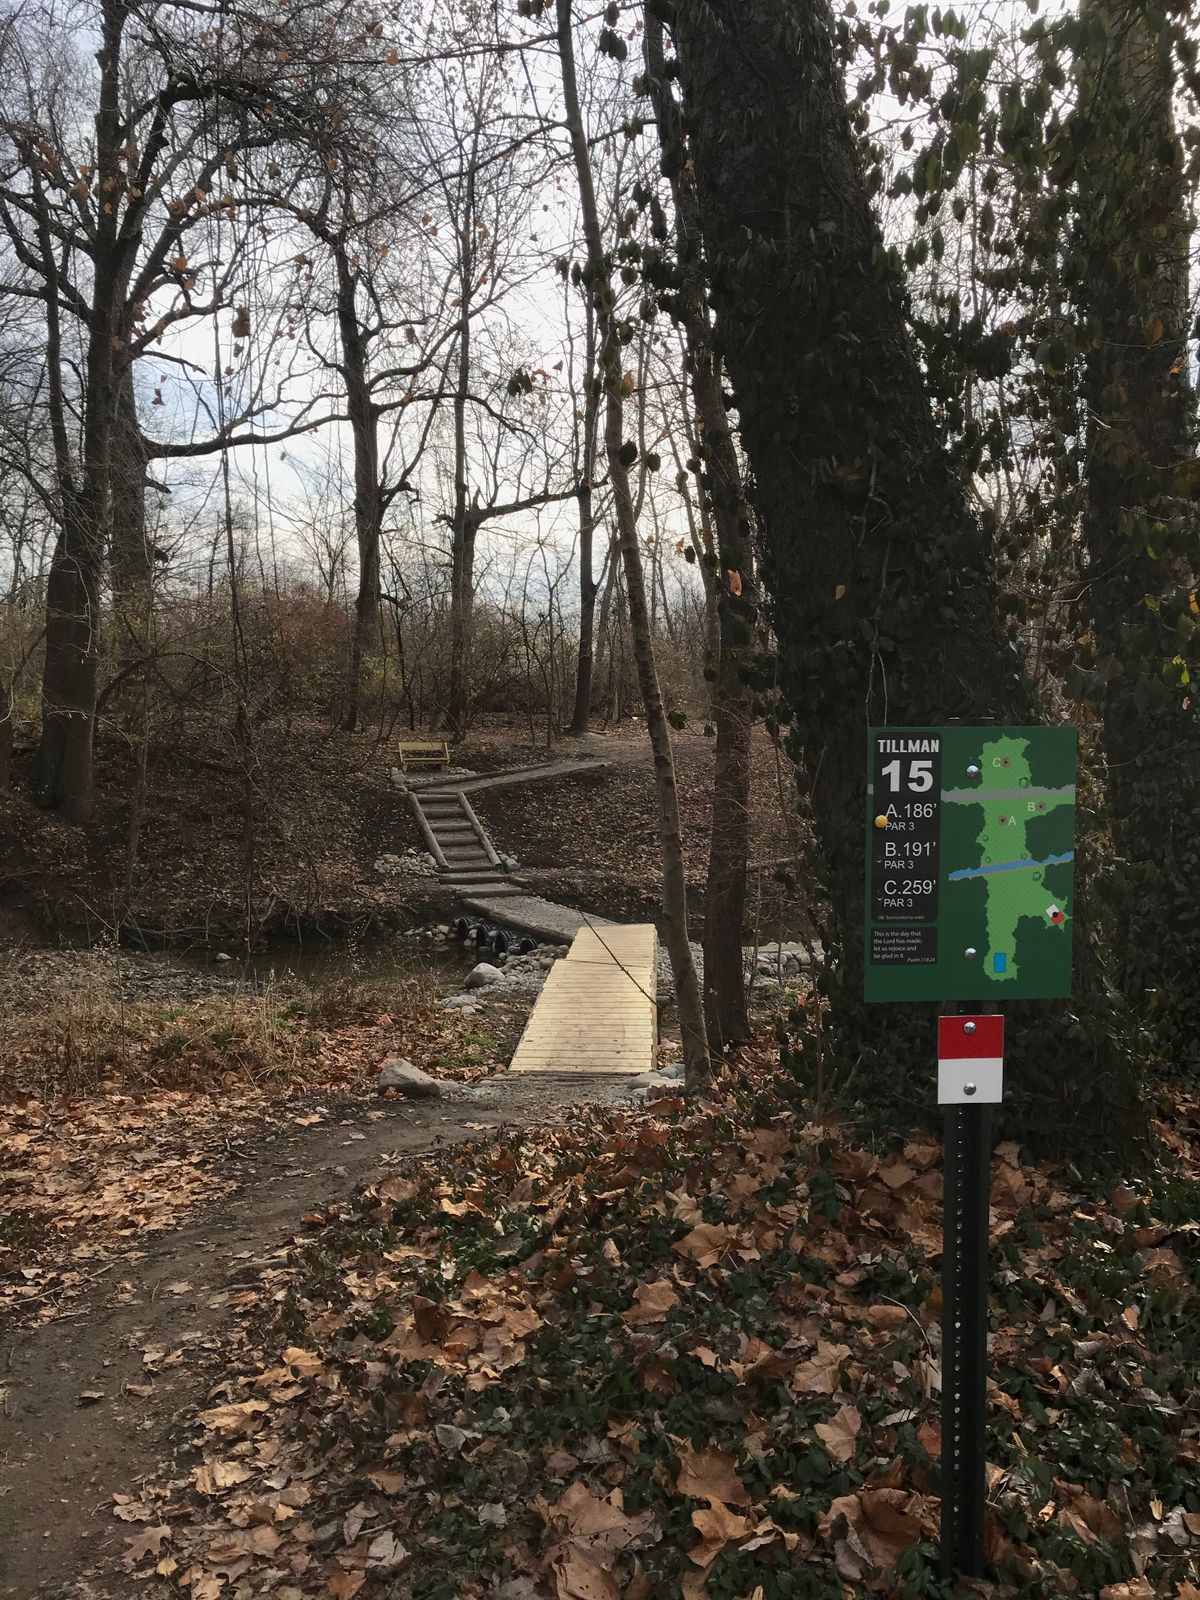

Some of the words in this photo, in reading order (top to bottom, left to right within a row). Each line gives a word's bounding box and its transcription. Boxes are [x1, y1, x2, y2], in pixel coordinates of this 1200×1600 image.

[877, 739, 940, 753] TILLMAN
[992, 757, 1001, 768] C
[881, 759, 934, 793] 15
[1027, 802, 1036, 812] B
[1008, 816, 1017, 825] A
[885, 821, 906, 831] PAR
[908, 821, 915, 831] 3
[884, 860, 905, 869] PAR
[908, 860, 914, 869] 3
[883, 898, 905, 907] PAR
[907, 898, 913, 907] 3
